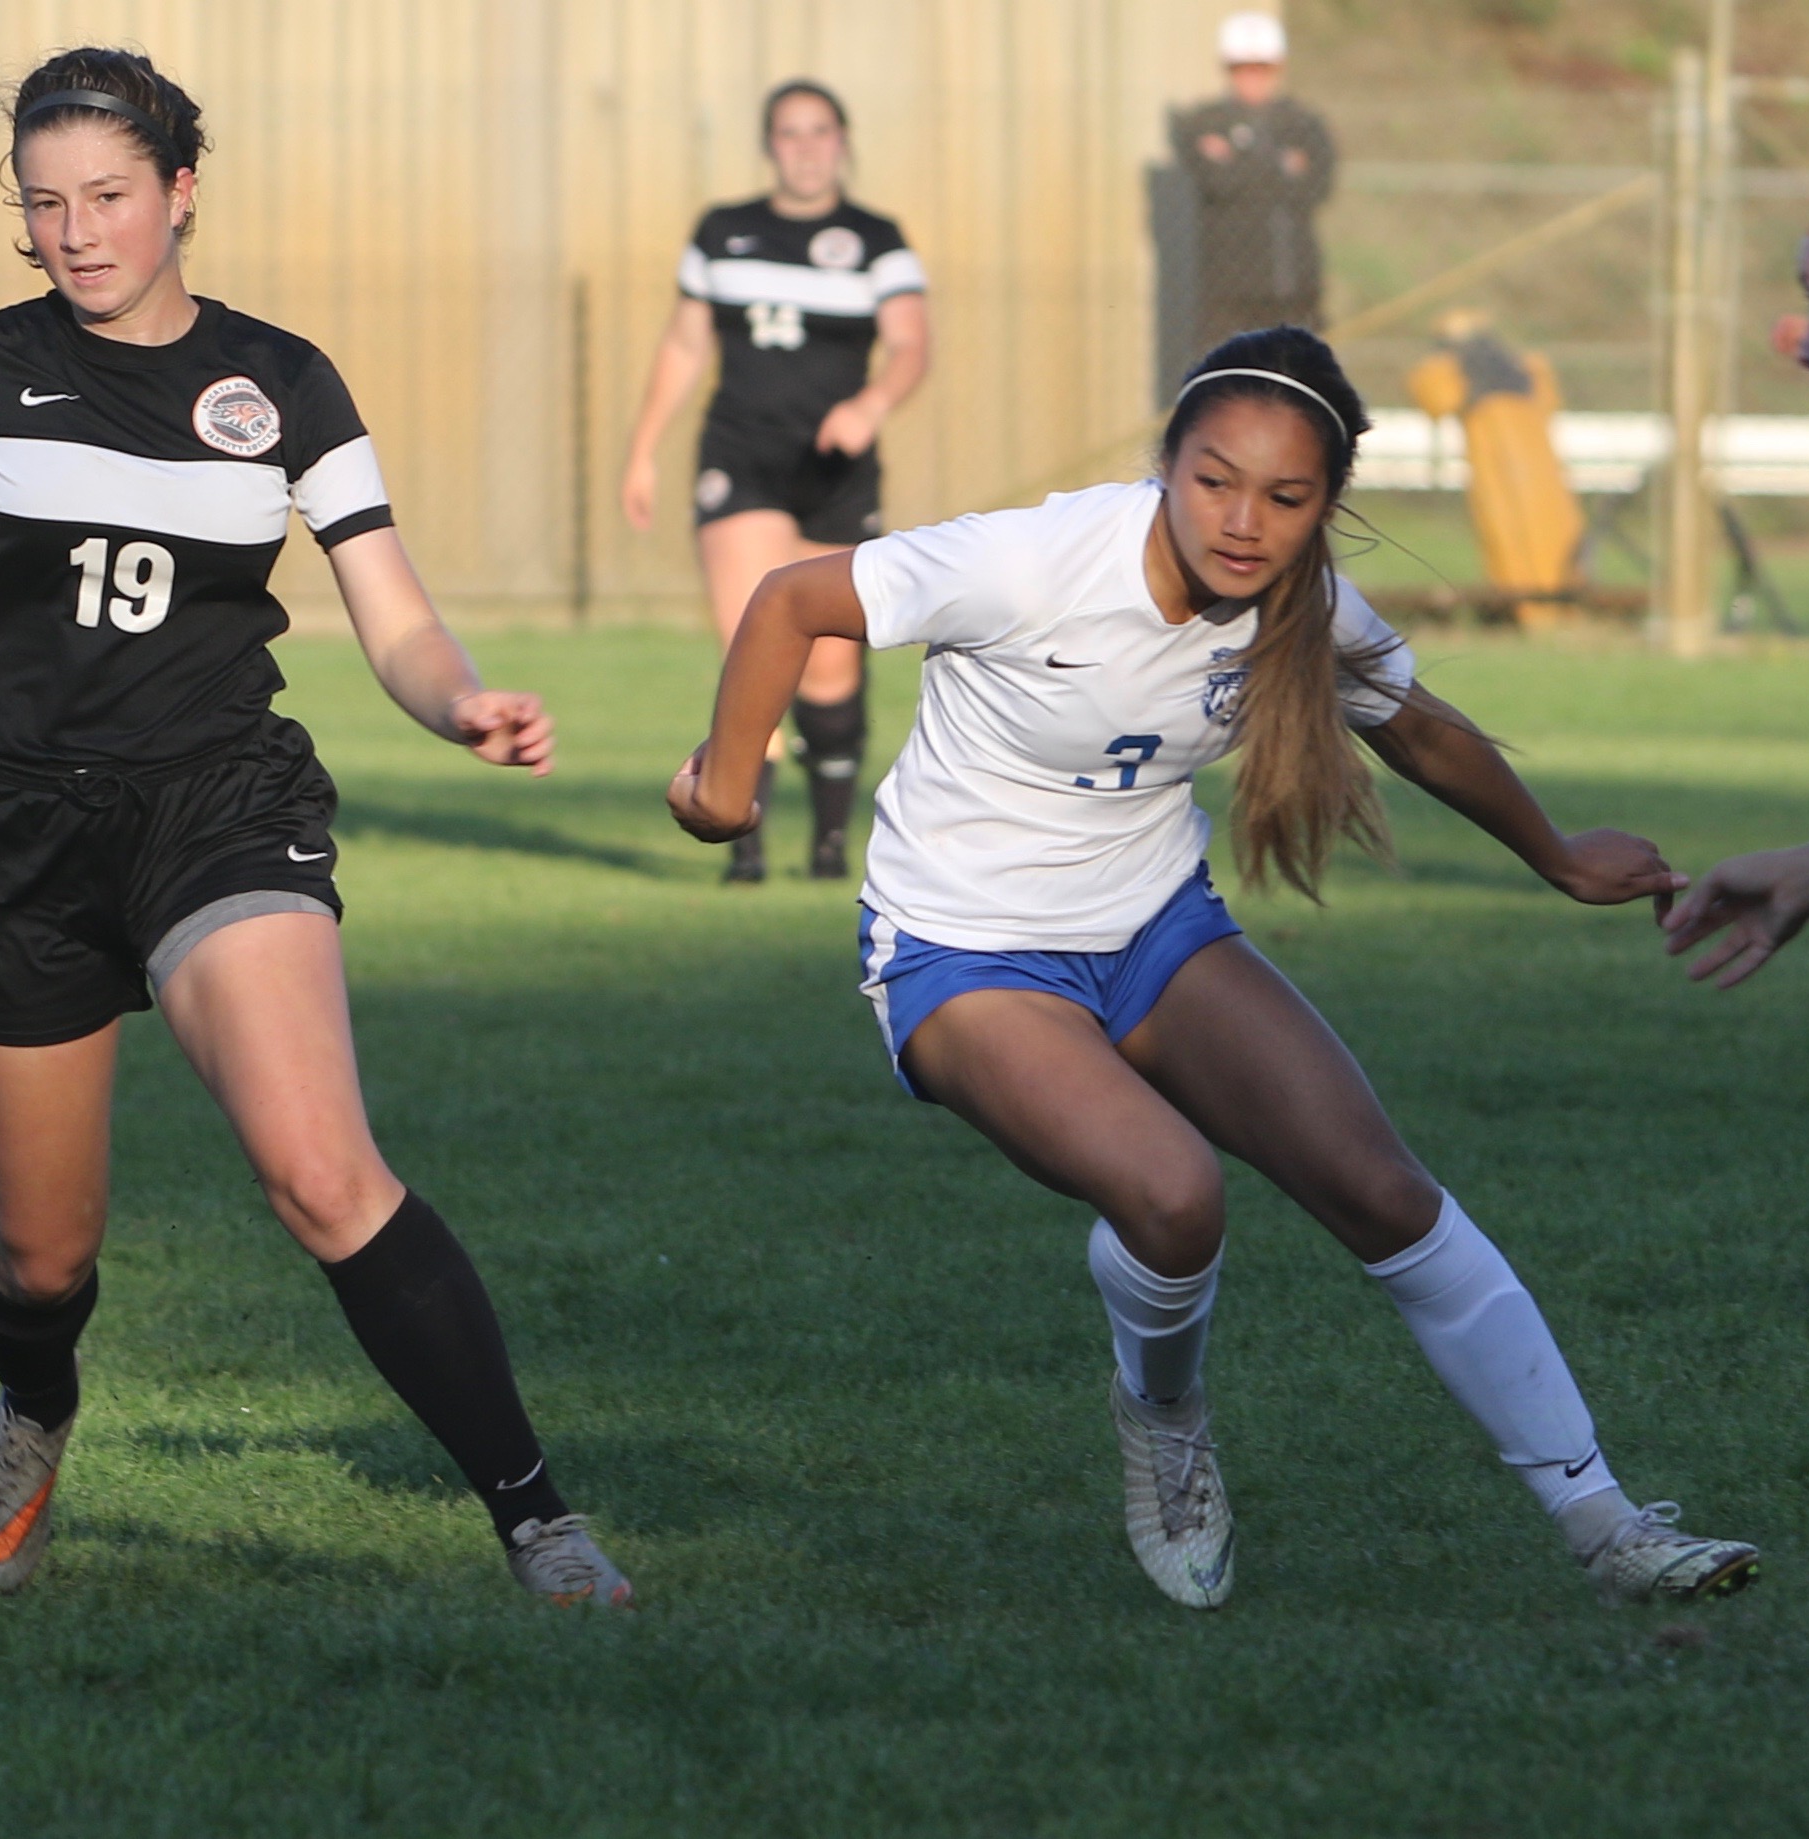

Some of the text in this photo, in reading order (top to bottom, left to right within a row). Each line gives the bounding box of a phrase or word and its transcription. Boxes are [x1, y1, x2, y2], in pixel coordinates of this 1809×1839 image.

[201, 384, 232, 409] ARCATA
[204, 427, 277, 453] VARSITY SOCCER
[70, 537, 176, 634] 19
[1074, 734, 1163, 789] 3
